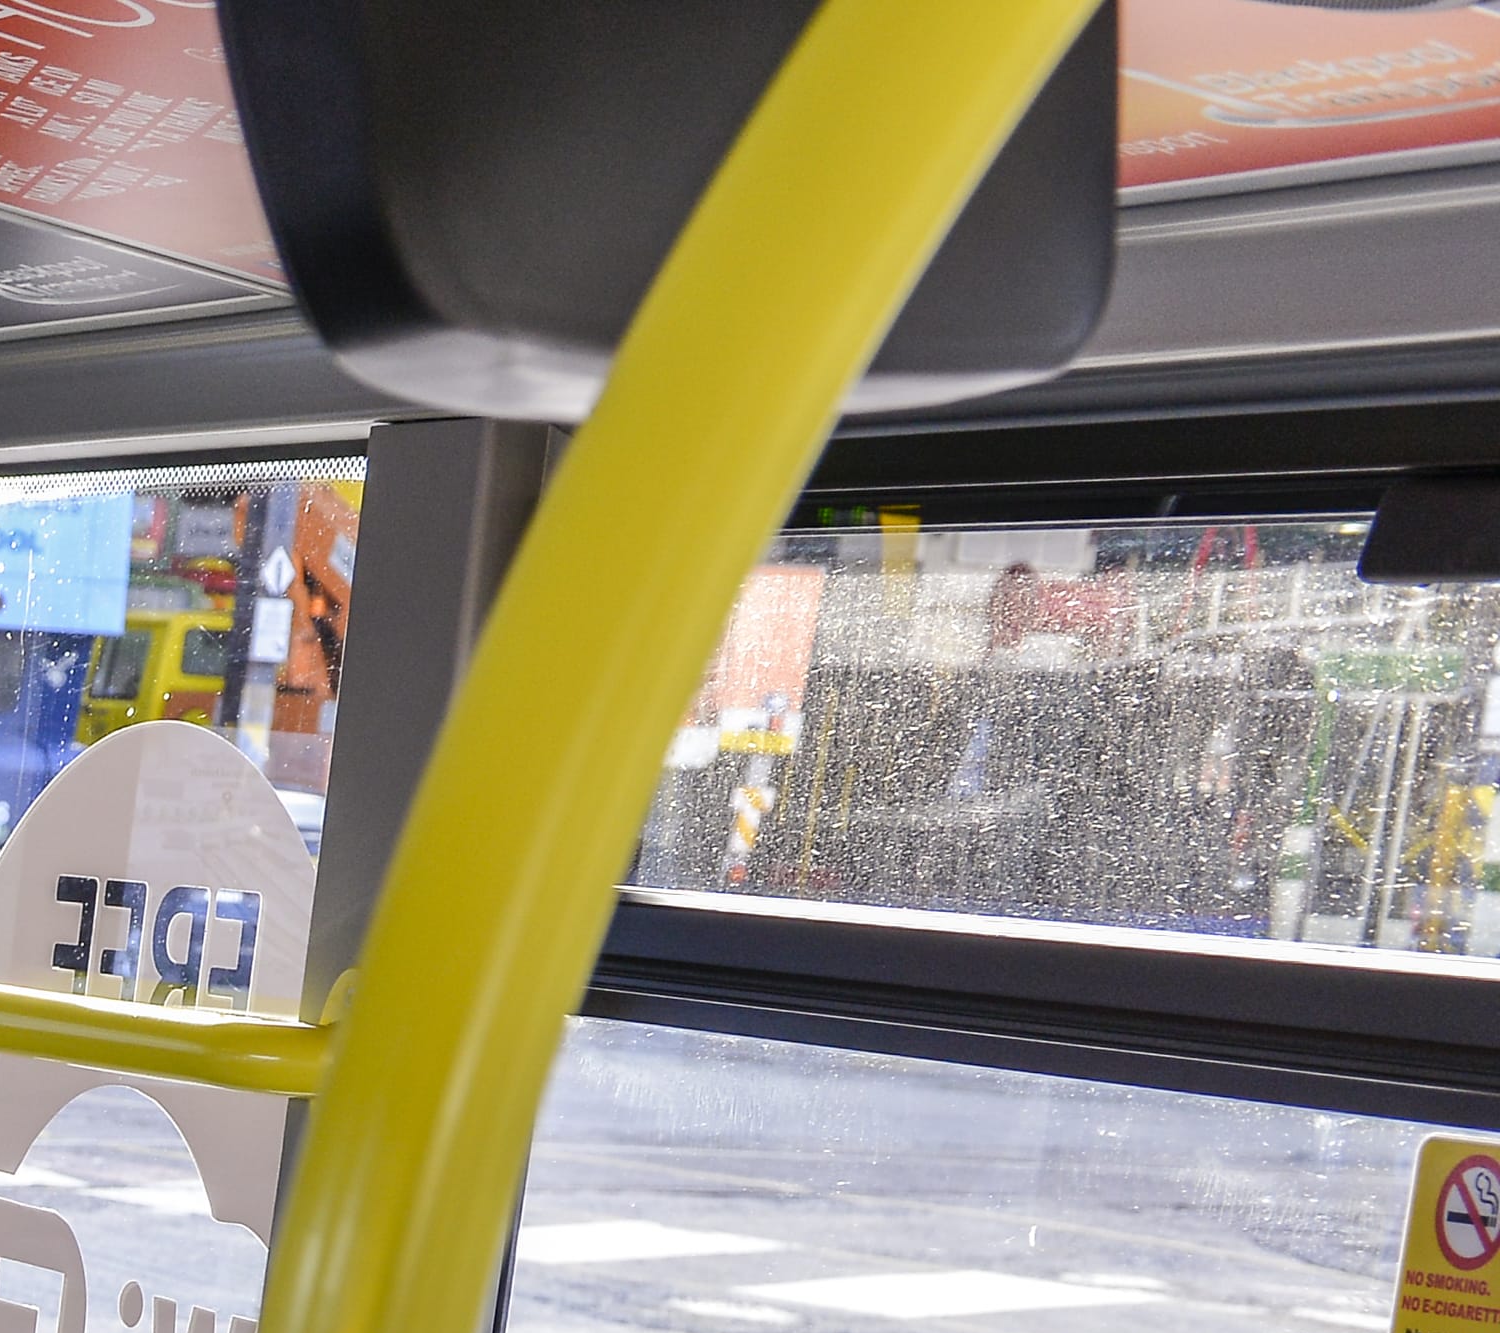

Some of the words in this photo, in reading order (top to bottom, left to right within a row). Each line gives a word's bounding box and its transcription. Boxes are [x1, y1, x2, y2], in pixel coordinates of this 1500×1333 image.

[1405, 1269, 1424, 1287] NO
[1426, 1273, 1492, 1297] SMOKING.
[1402, 1295, 1421, 1312] NO
[1422, 1299, 1500, 1325] E-CIGARETT
